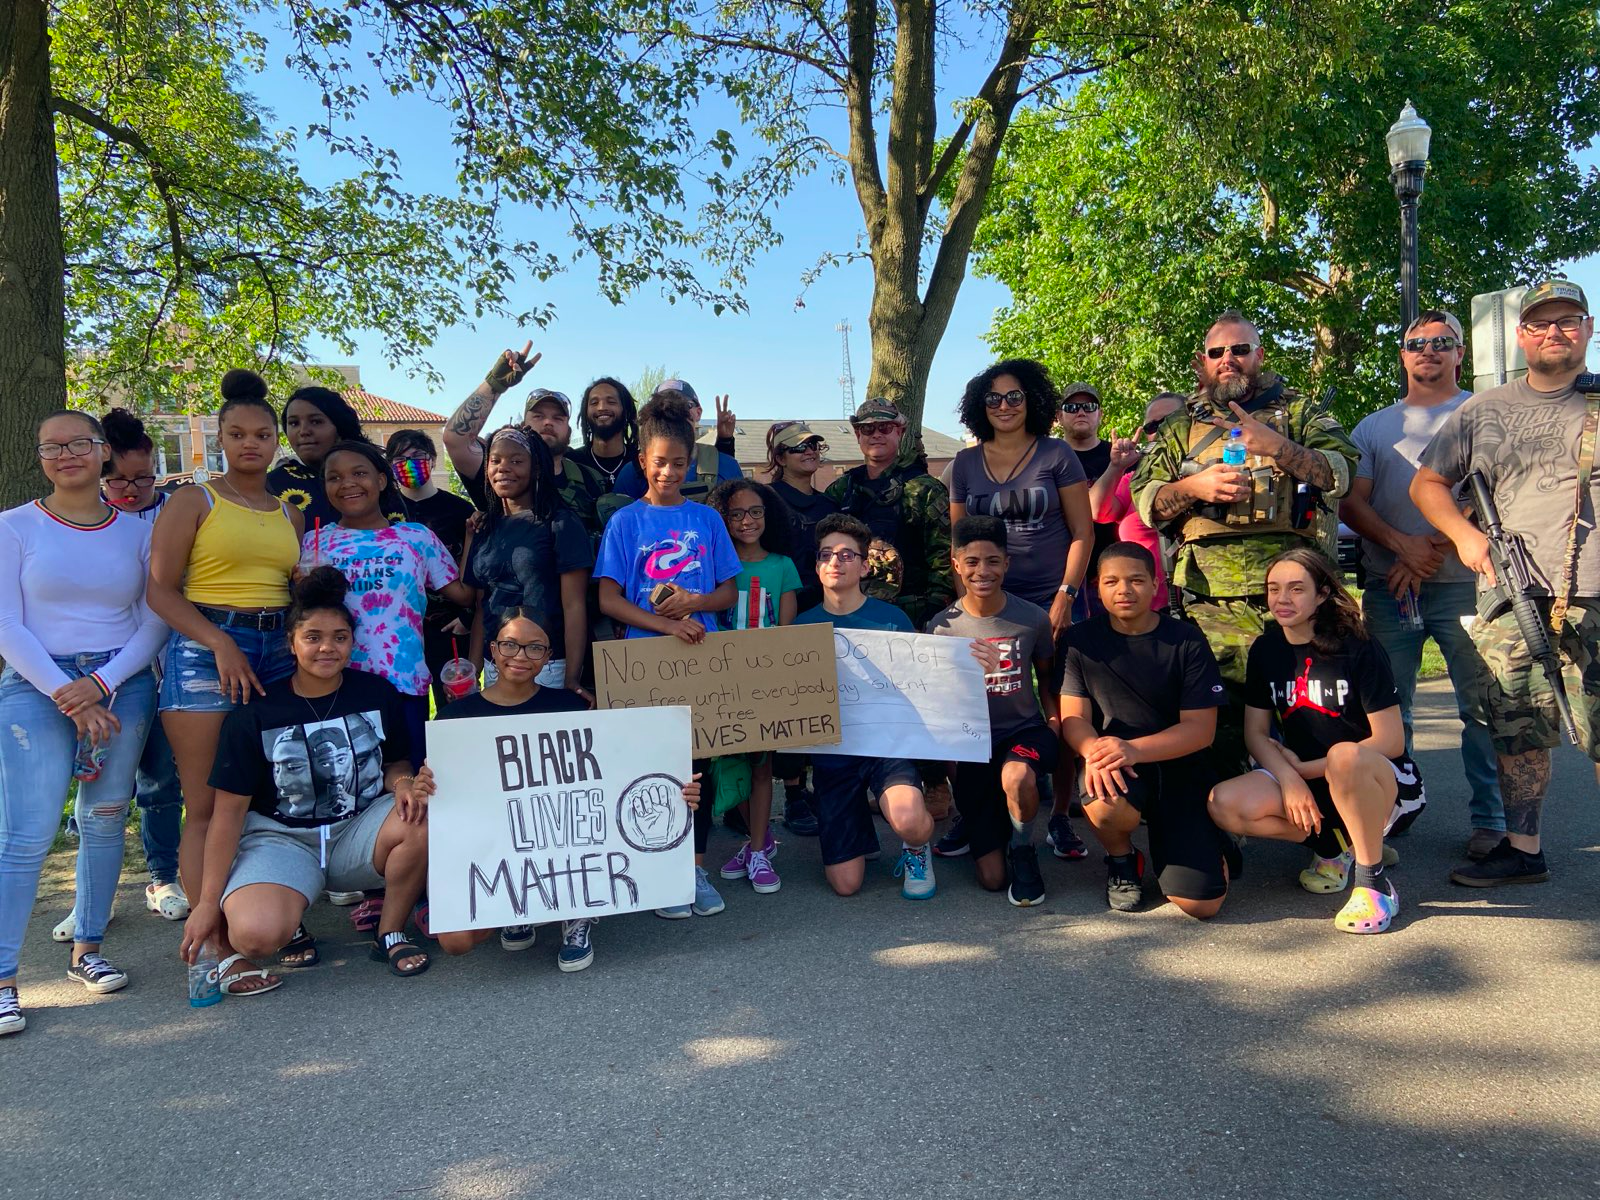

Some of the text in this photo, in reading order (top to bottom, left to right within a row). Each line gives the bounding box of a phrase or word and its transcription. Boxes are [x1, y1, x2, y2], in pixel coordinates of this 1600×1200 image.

[332, 556, 404, 567] PROTECT
[341, 567, 396, 578] TRANS
[347, 579, 384, 592] KIDS
[834, 632, 869, 660] Do
[602, 642, 820, 684] No one of us can
[648, 687, 686, 706] free
[695, 683, 741, 706] until
[752, 678, 836, 707] everybody
[838, 684, 859, 702] ay
[716, 703, 757, 721] free
[692, 714, 835, 750] IVES MATTER
[495, 727, 602, 792] BLACK
[506, 788, 607, 851] LIVES
[468, 852, 639, 923] MATTER
